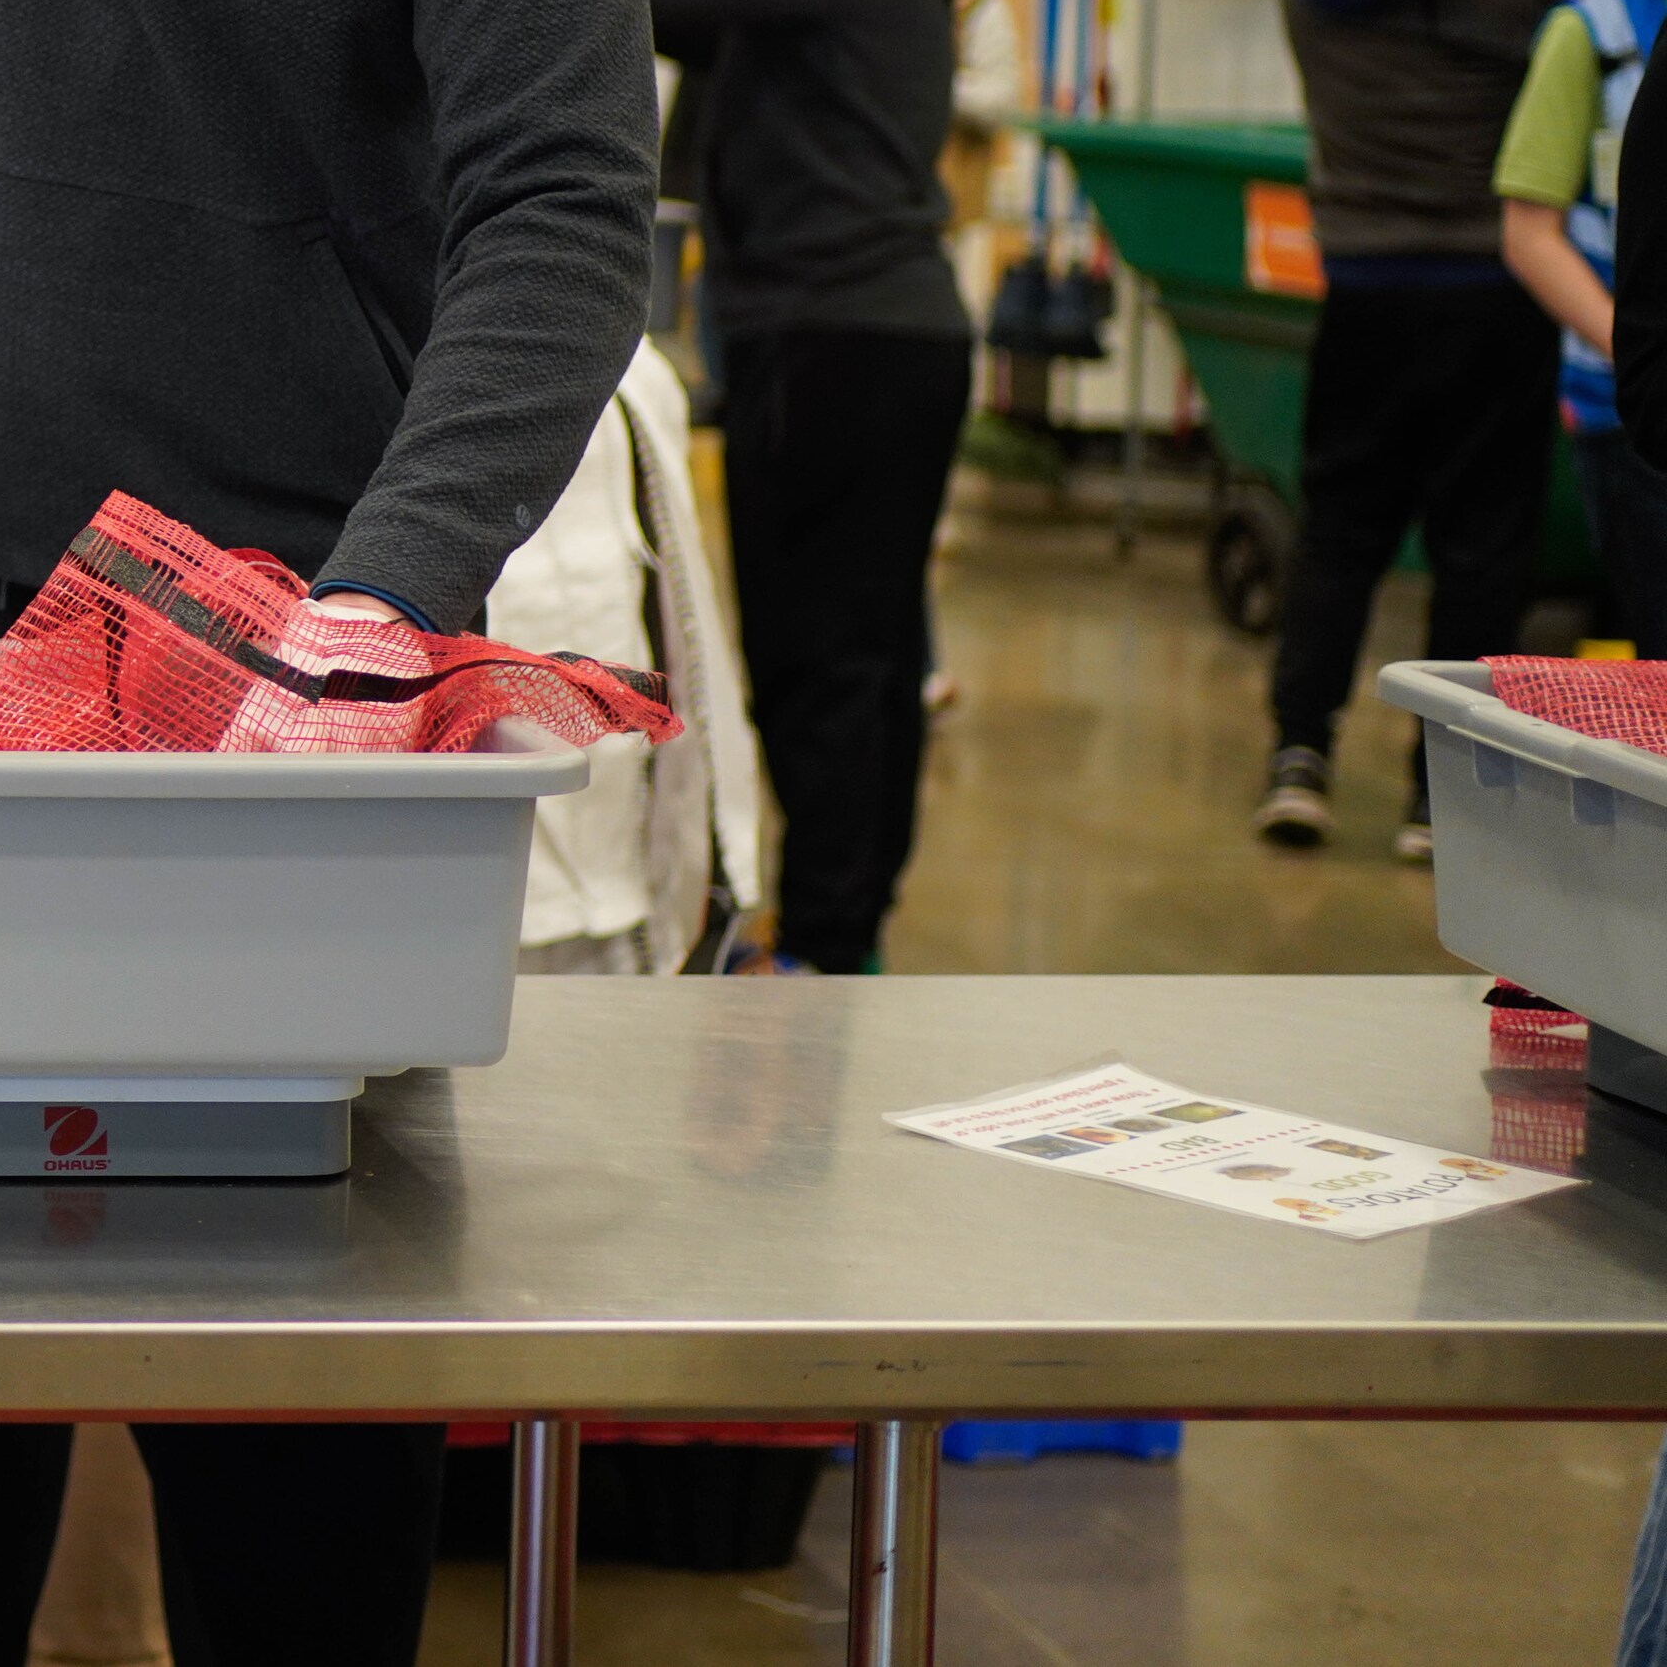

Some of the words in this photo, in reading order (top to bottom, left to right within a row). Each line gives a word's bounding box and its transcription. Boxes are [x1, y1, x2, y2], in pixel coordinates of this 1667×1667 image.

[1159, 1135, 1223, 1151] BAD
[43, 1159, 108, 1171] OHAUS
[1309, 1170, 1392, 1191] GOOD
[1325, 1173, 1466, 1209] POTATOES
